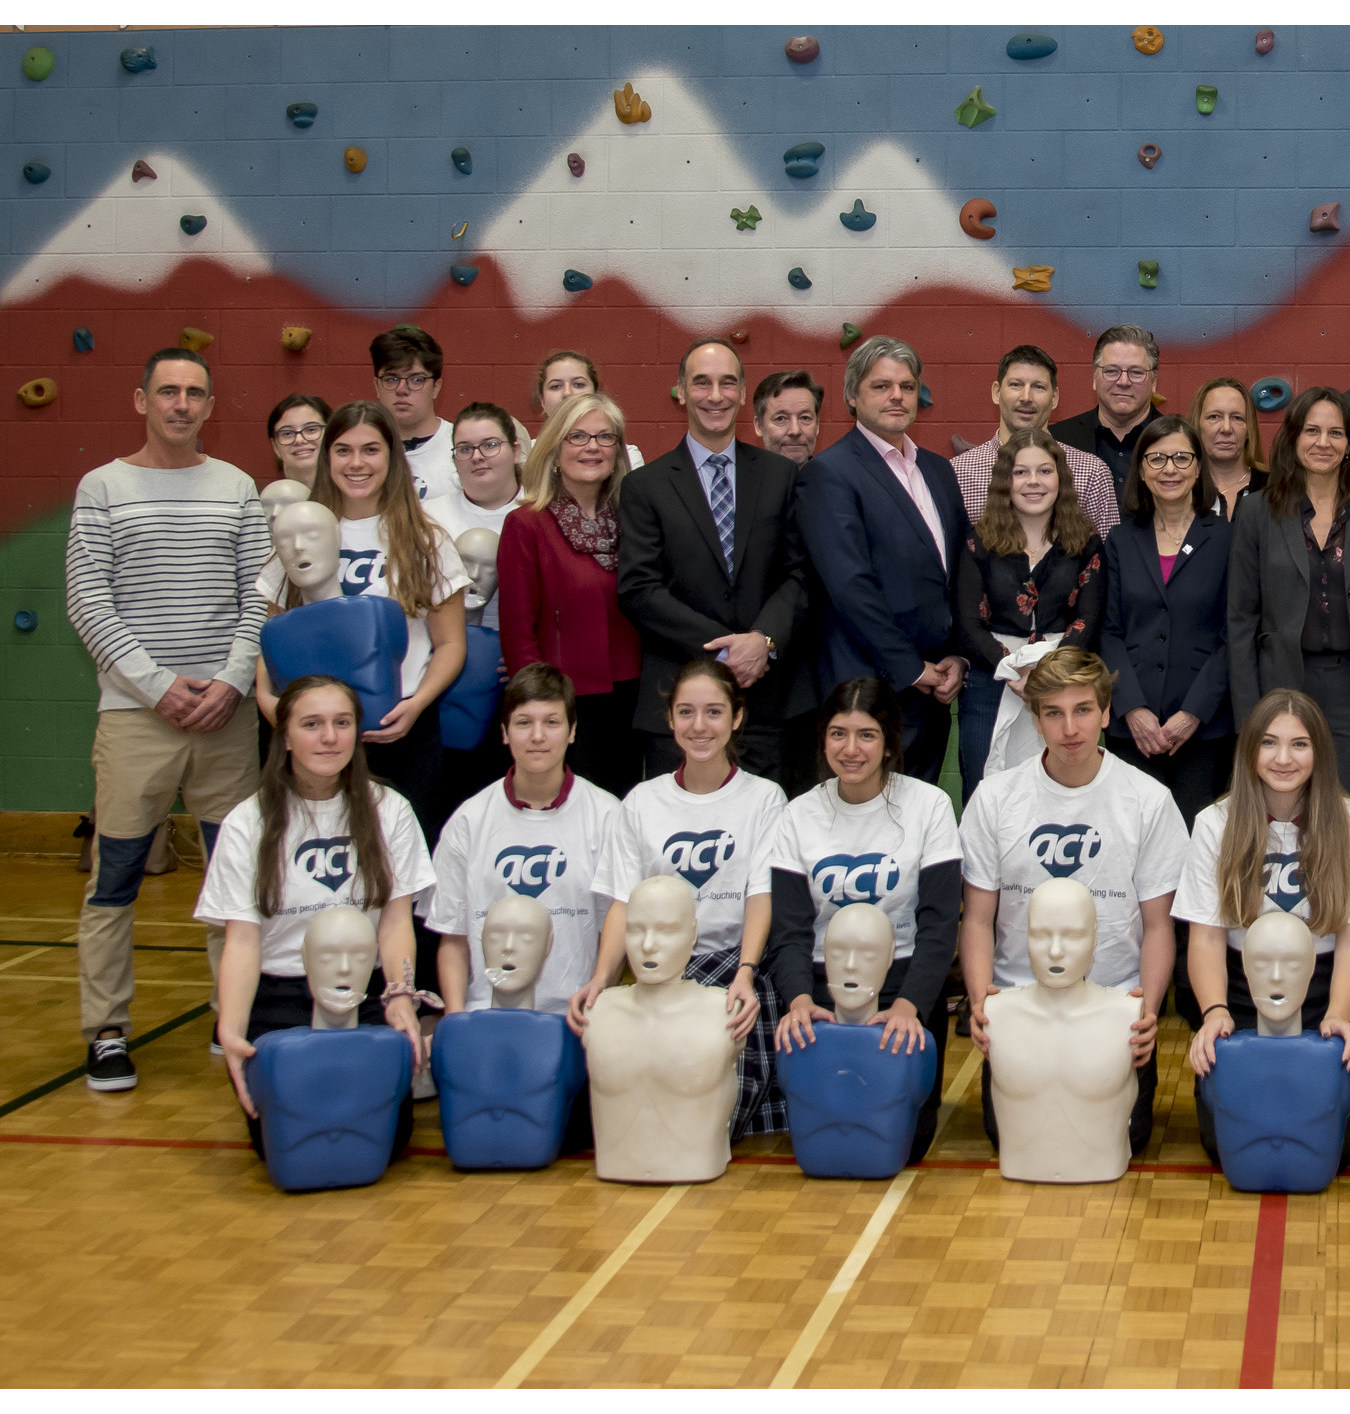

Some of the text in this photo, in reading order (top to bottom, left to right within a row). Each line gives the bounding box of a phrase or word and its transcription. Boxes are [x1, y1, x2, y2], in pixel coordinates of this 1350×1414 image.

[663, 830, 735, 872] act
[1029, 827, 1101, 866] act
[495, 847, 566, 886] act
[813, 854, 899, 901] act
[1001, 882, 1022, 893] Saving
[1108, 889, 1126, 898] lives
[299, 902, 326, 913] people
